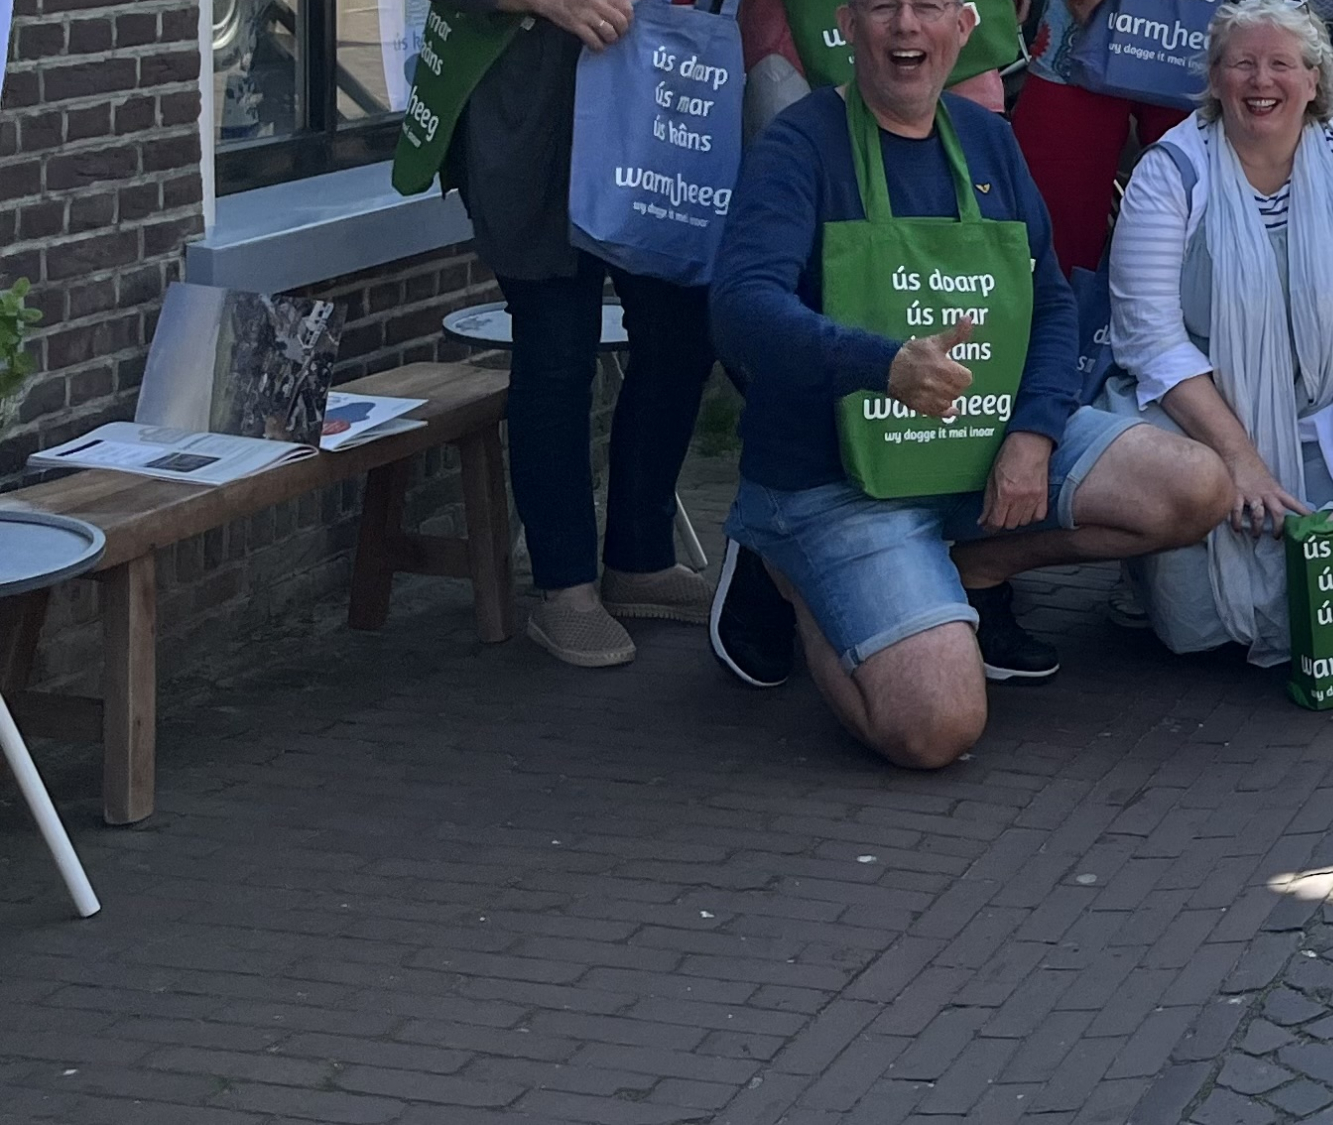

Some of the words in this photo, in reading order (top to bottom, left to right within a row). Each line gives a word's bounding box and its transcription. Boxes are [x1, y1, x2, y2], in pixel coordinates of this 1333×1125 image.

[653, 45, 676, 72] ús
[655, 80, 674, 108] ús
[676, 95, 715, 117] mar
[668, 120, 713, 152] kâns
[615, 166, 733, 215] warmheeg
[892, 265, 921, 291] ús
[929, 268, 996, 297] doarp
[906, 300, 934, 325] ús
[942, 307, 989, 326] mar
[884, 430, 902, 444] wy
[904, 427, 936, 443] dogge
[938, 426, 947, 439] it
[949, 426, 967, 438] mei
[969, 425, 995, 438] inoar
[1303, 535, 1332, 560] ús
